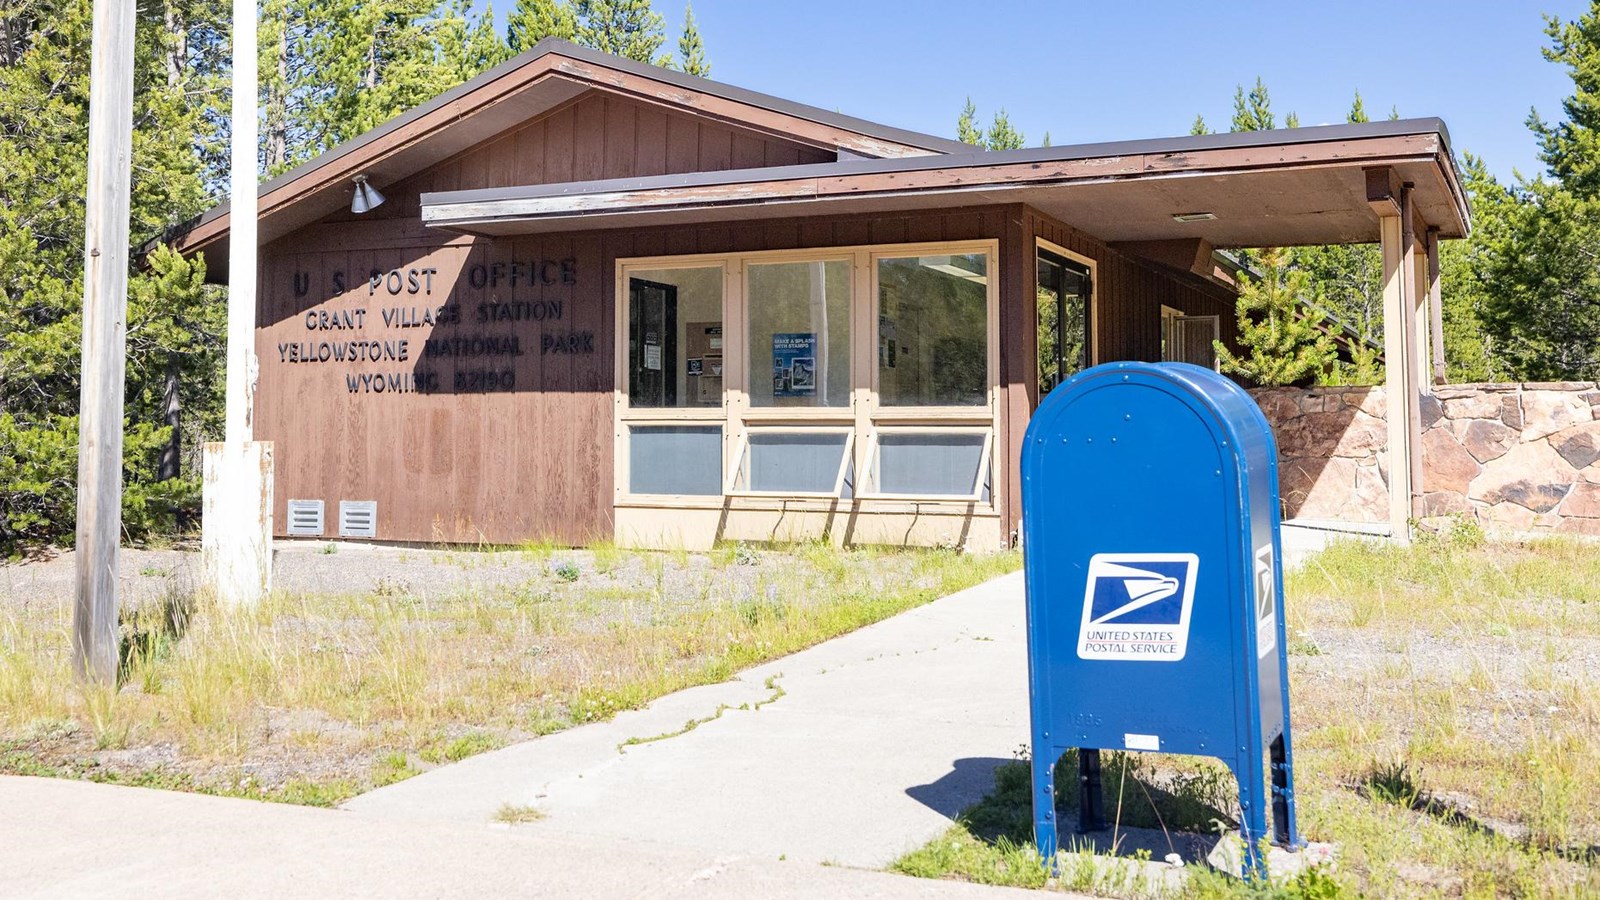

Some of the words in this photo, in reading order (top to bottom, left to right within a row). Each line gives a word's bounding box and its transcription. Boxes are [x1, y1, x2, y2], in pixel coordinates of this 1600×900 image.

[294, 272, 309, 298] U
[333, 269, 346, 295] S
[369, 267, 438, 296] POST
[469, 258, 577, 289] OFFICE
[305, 308, 366, 331] GRANT
[382, 303, 461, 329] VILLAGE
[476, 301, 563, 324] STATION
[278, 339, 409, 363] YELLOWSTONE
[425, 335, 524, 358] NATIONAL
[541, 331, 594, 355] PARK
[346, 372, 439, 394] WYOMING
[454, 371, 516, 391] 82190
[1085, 643, 1128, 652] POSTAL
[1130, 643, 1178, 653] SERVICE
[1087, 631, 1130, 640] UNITED
[1132, 631, 1173, 641] STATES
